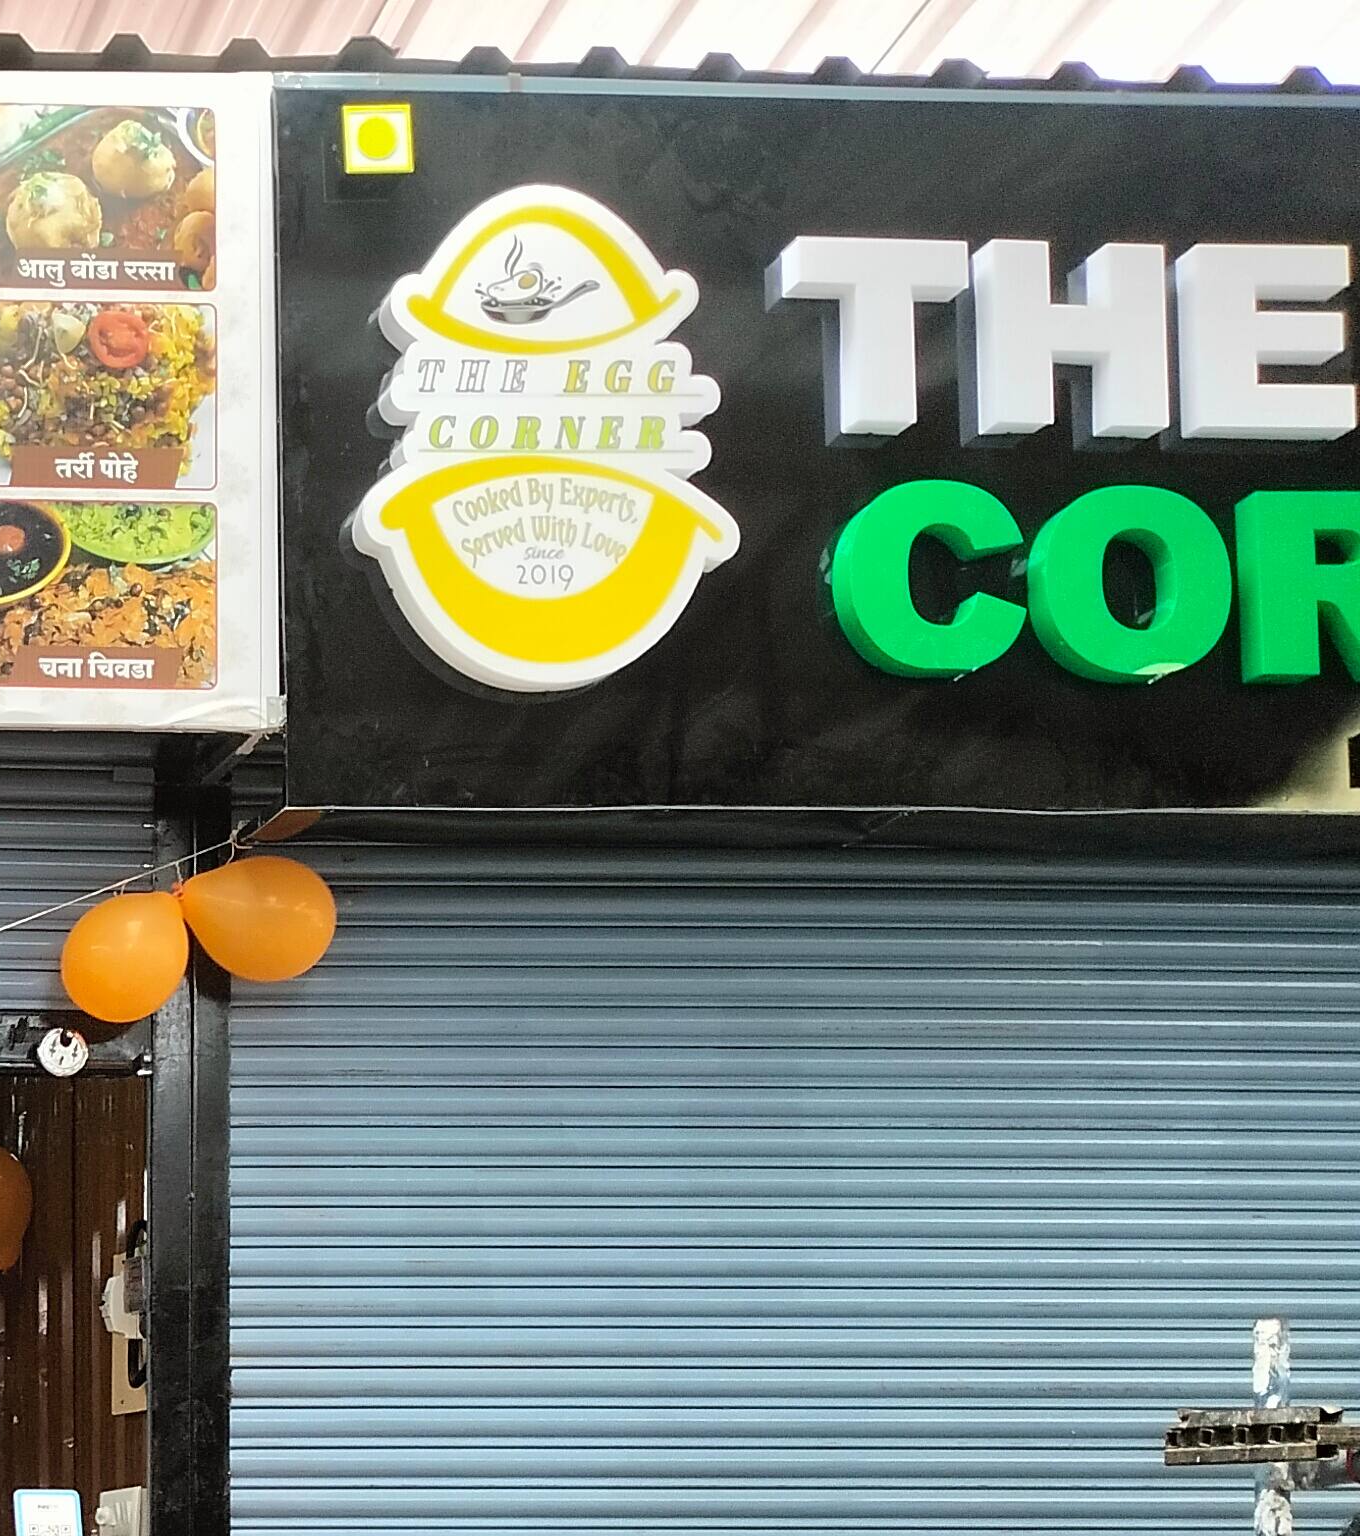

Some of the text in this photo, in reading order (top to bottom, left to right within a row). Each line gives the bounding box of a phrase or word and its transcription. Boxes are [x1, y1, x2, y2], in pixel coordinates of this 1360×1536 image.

[17, 253, 176, 287] आलु बोंडा रस्सा
[780, 236, 1358, 440] THE
[418, 359, 676, 393] THE EGG
[429, 415, 667, 449] CORNER
[100, 452, 139, 484] पोहे
[452, 477, 638, 526] Cooked By Experts,
[461, 515, 627, 568] Served With Love
[523, 546, 565, 560] since
[516, 564, 574, 591] 2019
[38, 651, 154, 679] चना चिवडा
